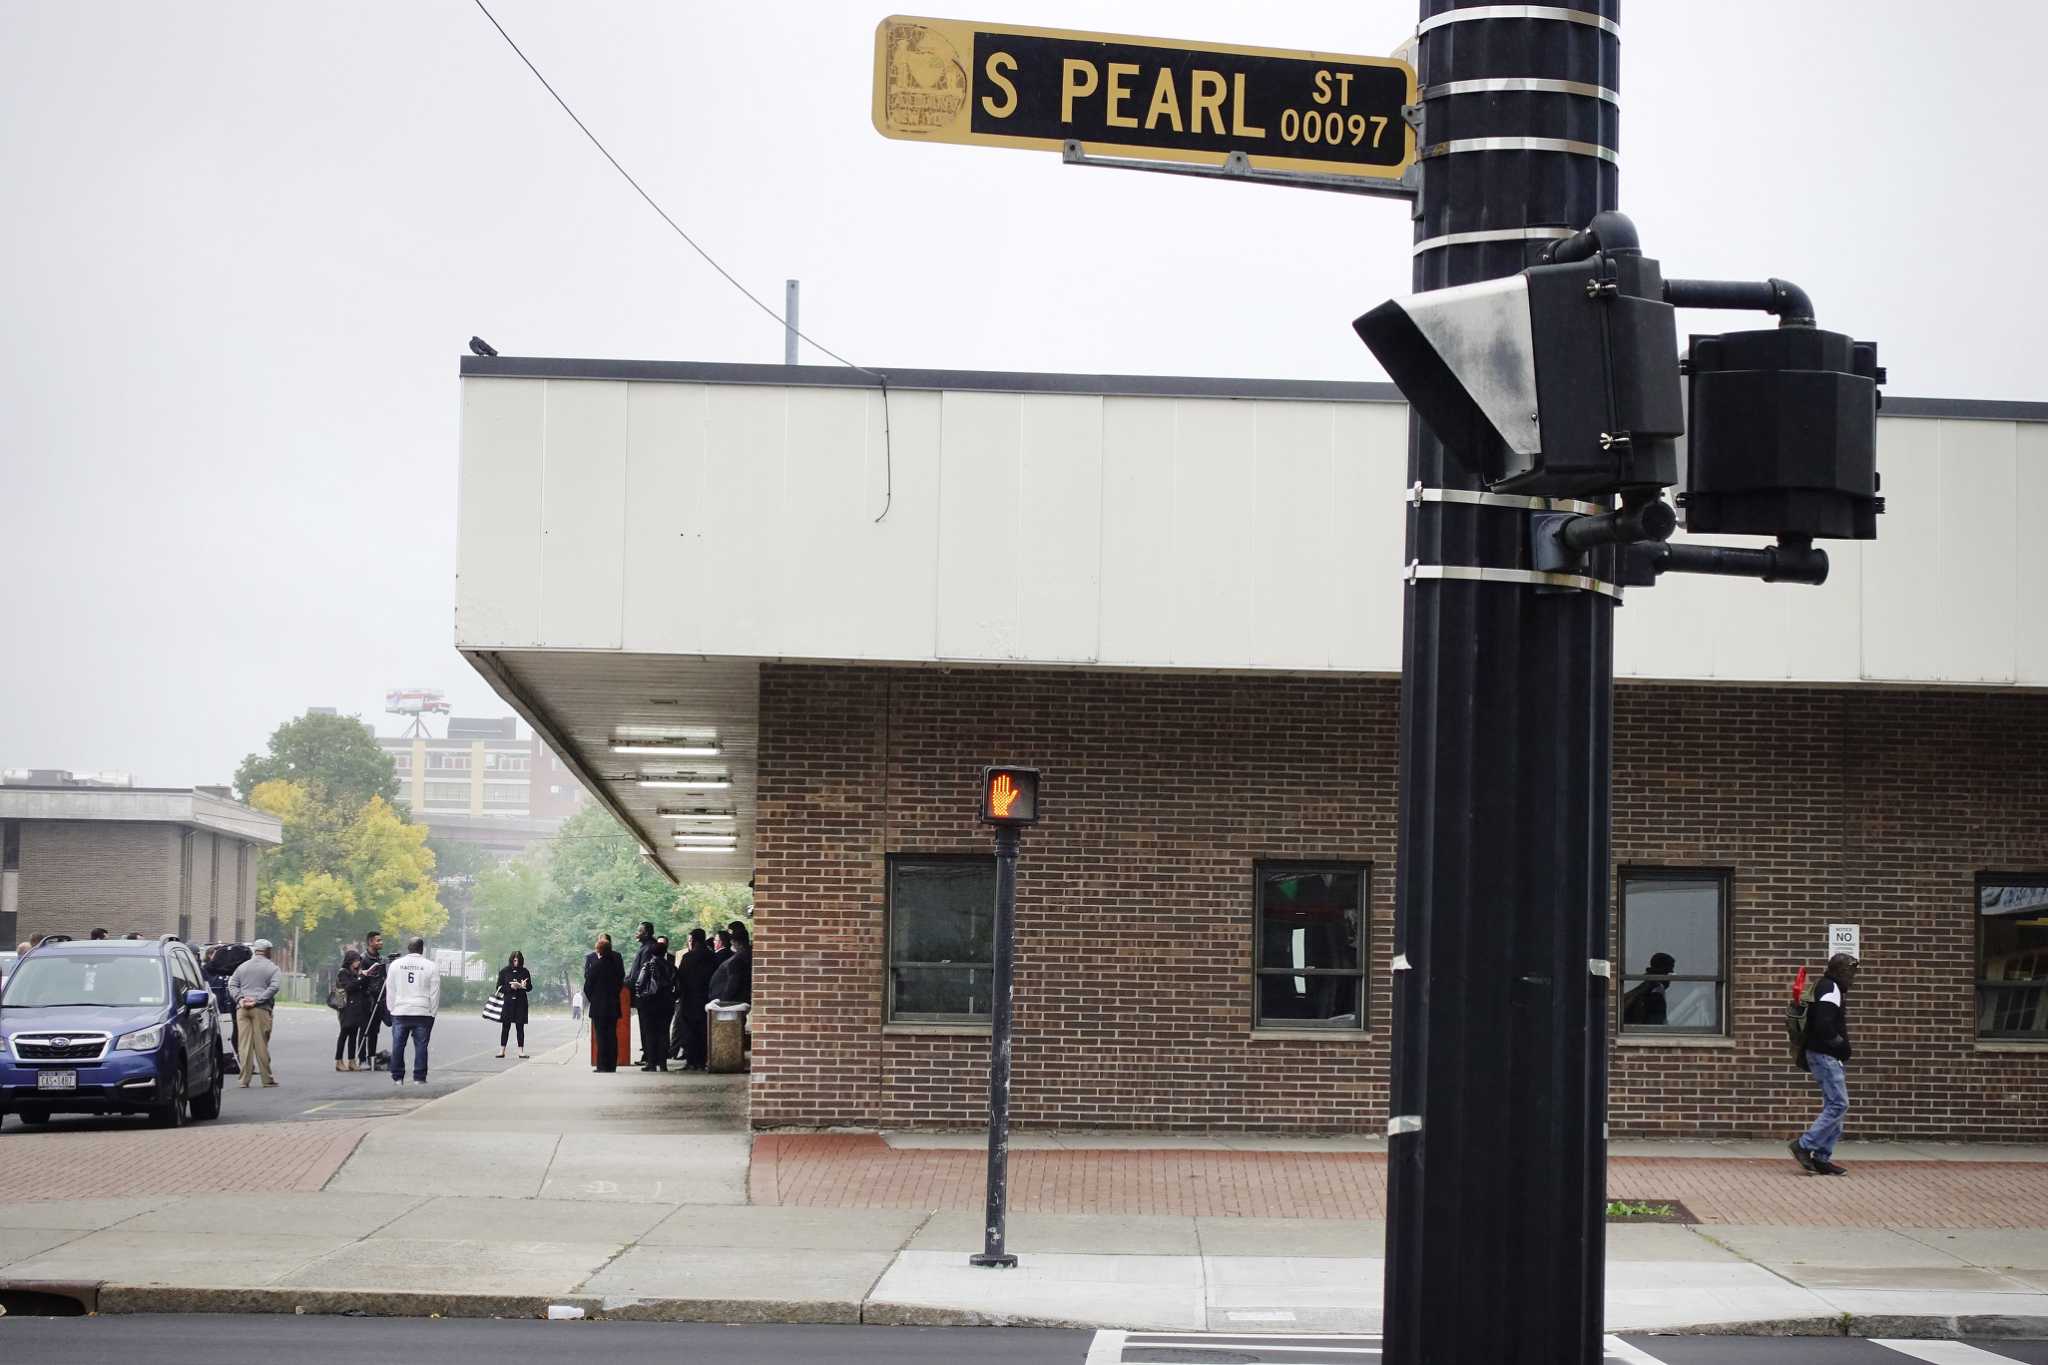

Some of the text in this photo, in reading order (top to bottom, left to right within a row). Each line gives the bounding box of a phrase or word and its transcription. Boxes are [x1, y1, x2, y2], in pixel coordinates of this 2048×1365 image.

[981, 51, 1018, 119] S
[1061, 58, 1266, 139] PEARL
[1312, 69, 1354, 107] ST
[1280, 108, 1388, 148] 00097
[1836, 932, 1852, 942] NO
[407, 972, 415, 984] 6
